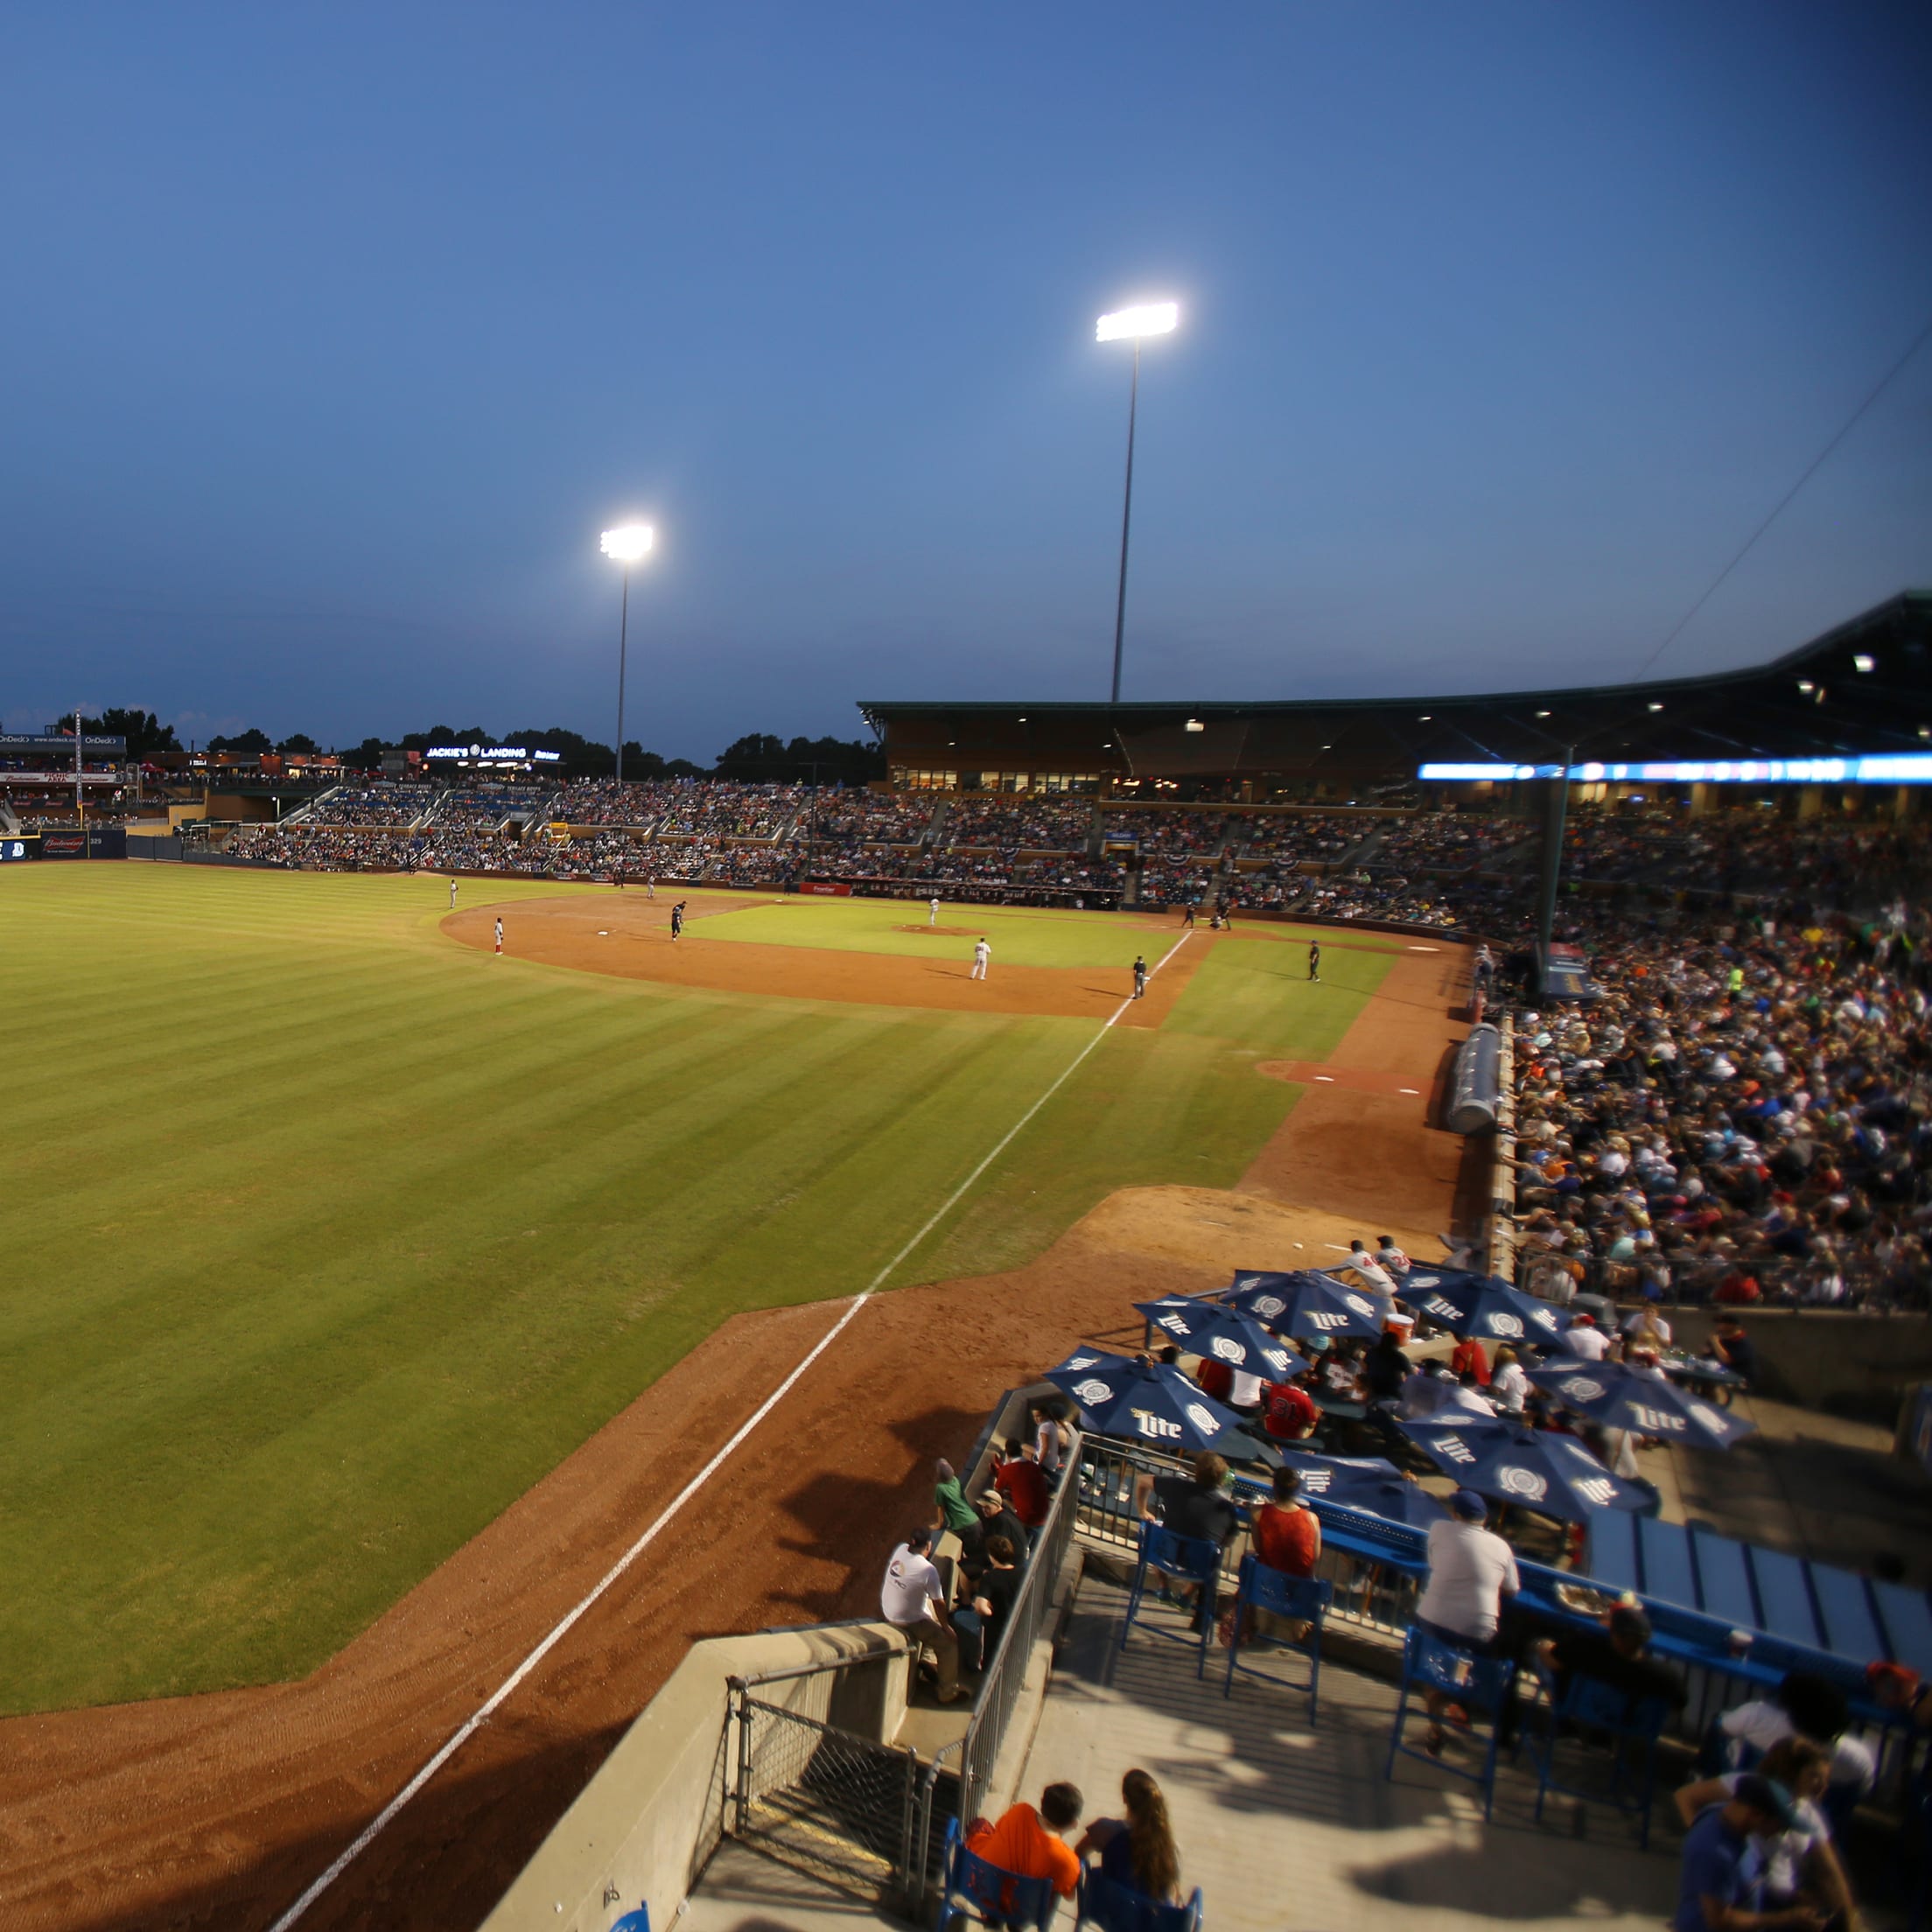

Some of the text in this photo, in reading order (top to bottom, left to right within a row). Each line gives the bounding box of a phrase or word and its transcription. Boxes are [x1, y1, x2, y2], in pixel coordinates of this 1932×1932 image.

[427, 748, 527, 758] JACKIE'S LANDING
[1424, 1298, 1465, 1320] Lite
[1310, 1312, 1350, 1331] Lite
[1138, 1413, 1182, 1438] Lite
[1634, 1404, 1686, 1431] Lite
[1433, 1435, 1476, 1464] Lite
